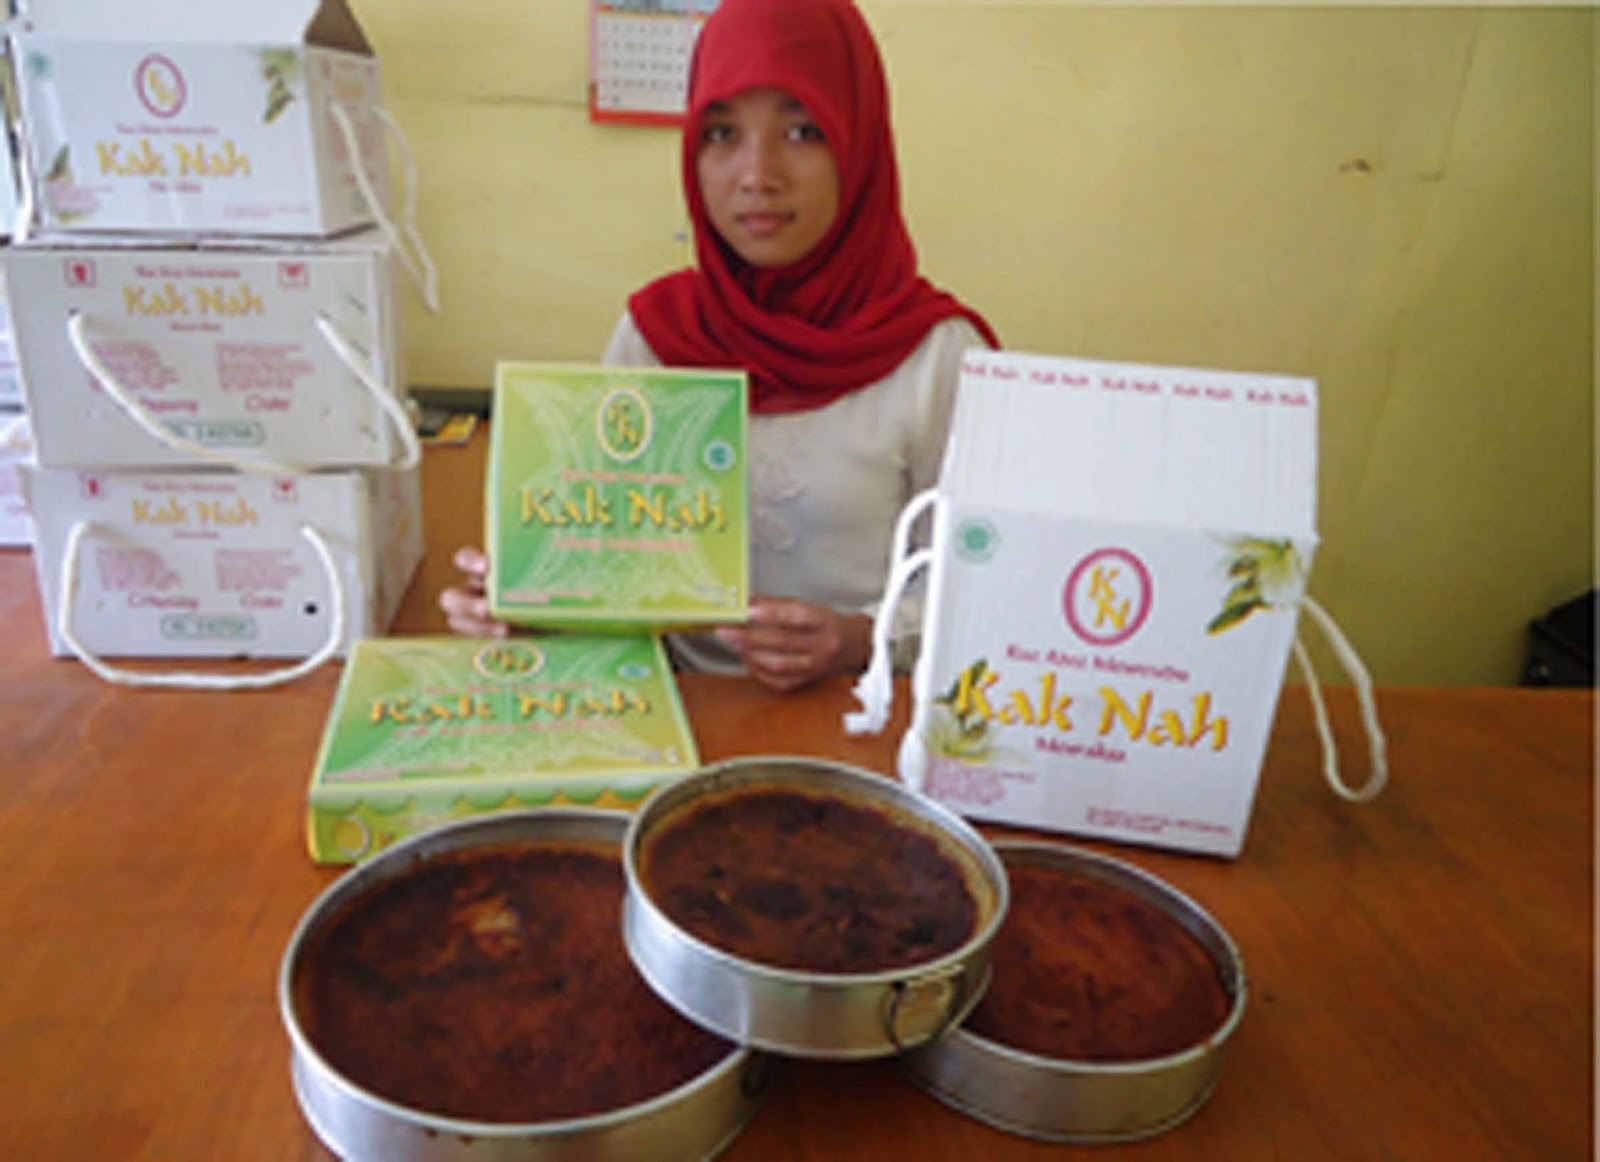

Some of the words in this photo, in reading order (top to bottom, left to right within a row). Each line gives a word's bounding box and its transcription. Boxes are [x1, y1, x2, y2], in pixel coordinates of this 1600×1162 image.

[95, 138, 168, 177] Kak
[172, 138, 251, 177] Nah
[122, 281, 190, 316] Kak
[193, 281, 264, 316] Nah
[131, 496, 190, 525] Kak
[195, 496, 259, 527] Nah
[520, 485, 613, 528] Kak
[627, 486, 727, 533] Nah
[370, 693, 496, 724] Kak
[518, 688, 652, 717] Nah
[956, 667, 1073, 732] Kak
[1097, 684, 1229, 753] Nah
